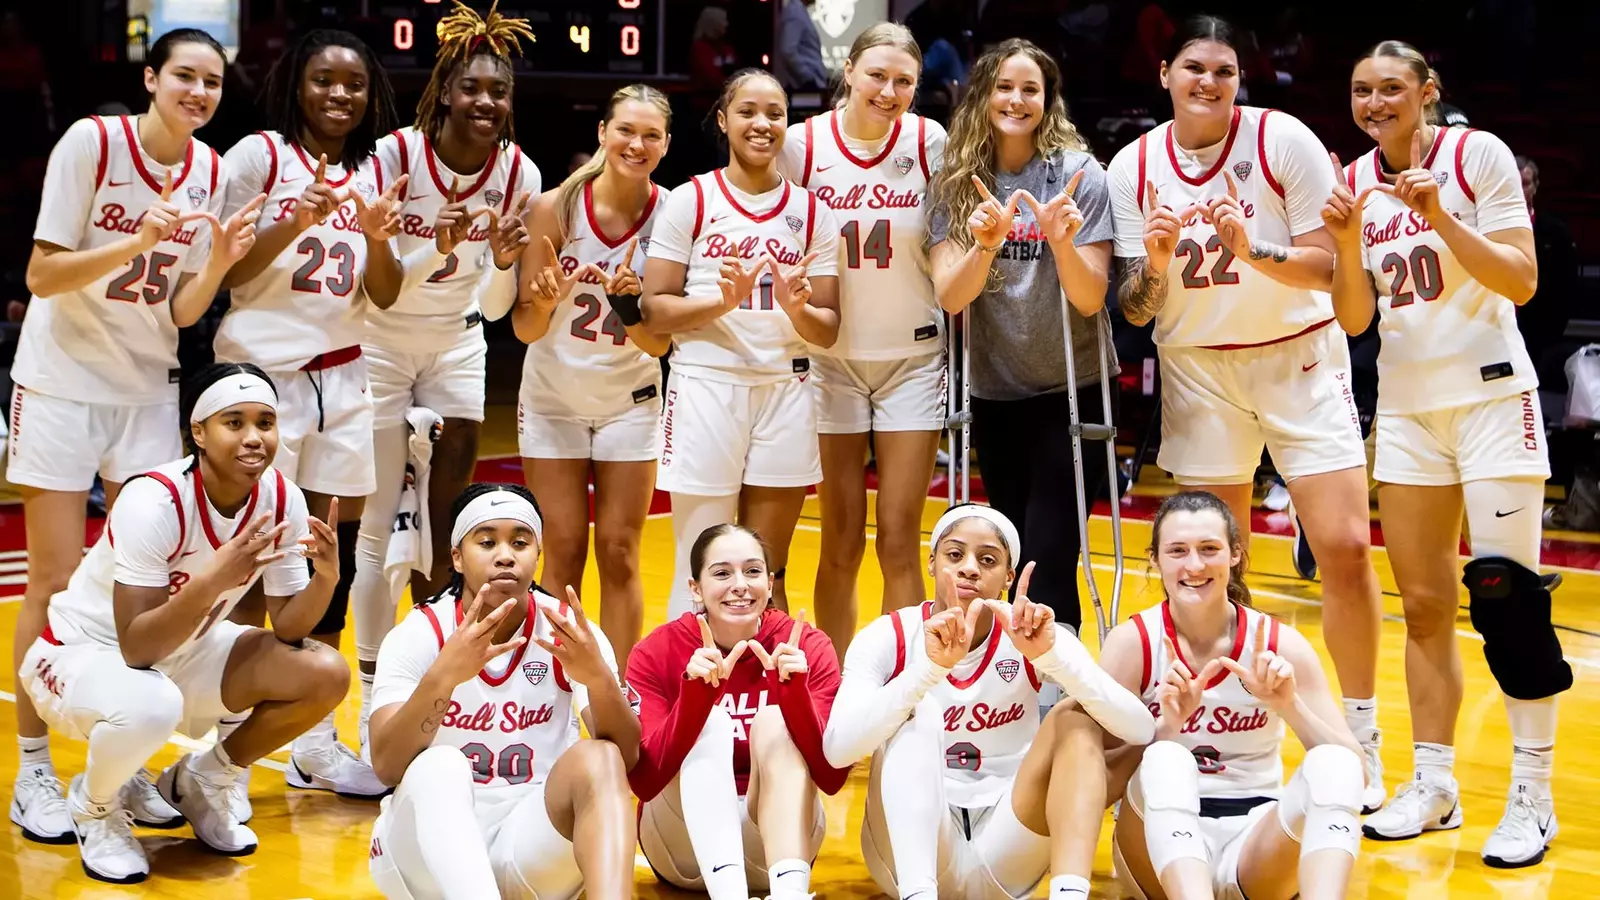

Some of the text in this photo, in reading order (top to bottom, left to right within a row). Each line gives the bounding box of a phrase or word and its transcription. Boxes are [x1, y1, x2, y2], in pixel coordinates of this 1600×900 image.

[393, 19, 413, 50] 0
[569, 25, 590, 53] 4
[621, 25, 640, 56] 0
[816, 184, 920, 210] Ball State
[94, 203, 149, 235] Bal
[1363, 212, 1403, 248] Ball
[760, 238, 802, 266] Stat
[841, 219, 893, 270] 14
[105, 251, 178, 305] 25
[291, 236, 355, 297] 23
[1175, 234, 1240, 289] 22
[1381, 244, 1444, 308] 20
[570, 292, 629, 346] 24
[440, 699, 495, 733] Ball
[718, 690, 769, 716] ALL
[965, 702, 1025, 732] State
[1207, 706, 1269, 734] State
[460, 742, 534, 785] 30
